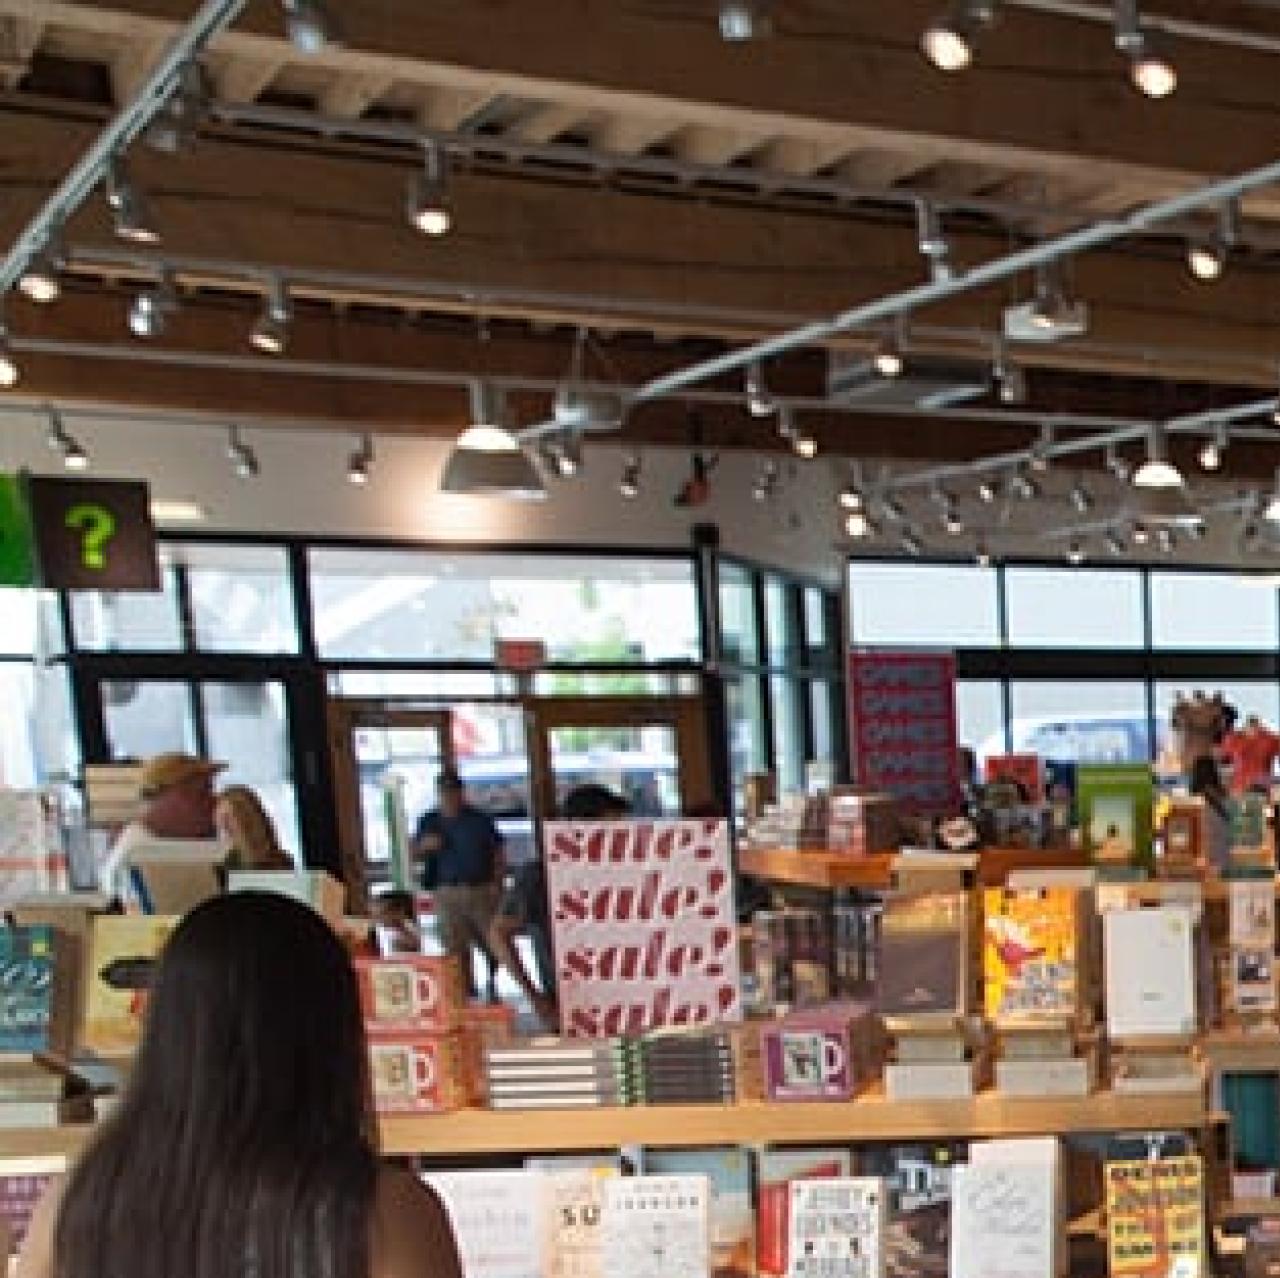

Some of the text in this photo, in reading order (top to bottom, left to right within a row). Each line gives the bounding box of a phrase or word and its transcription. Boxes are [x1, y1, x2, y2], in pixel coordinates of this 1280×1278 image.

[550, 821, 720, 863] sale!
[556, 869, 726, 922] sale!
[561, 926, 732, 980] sale!
